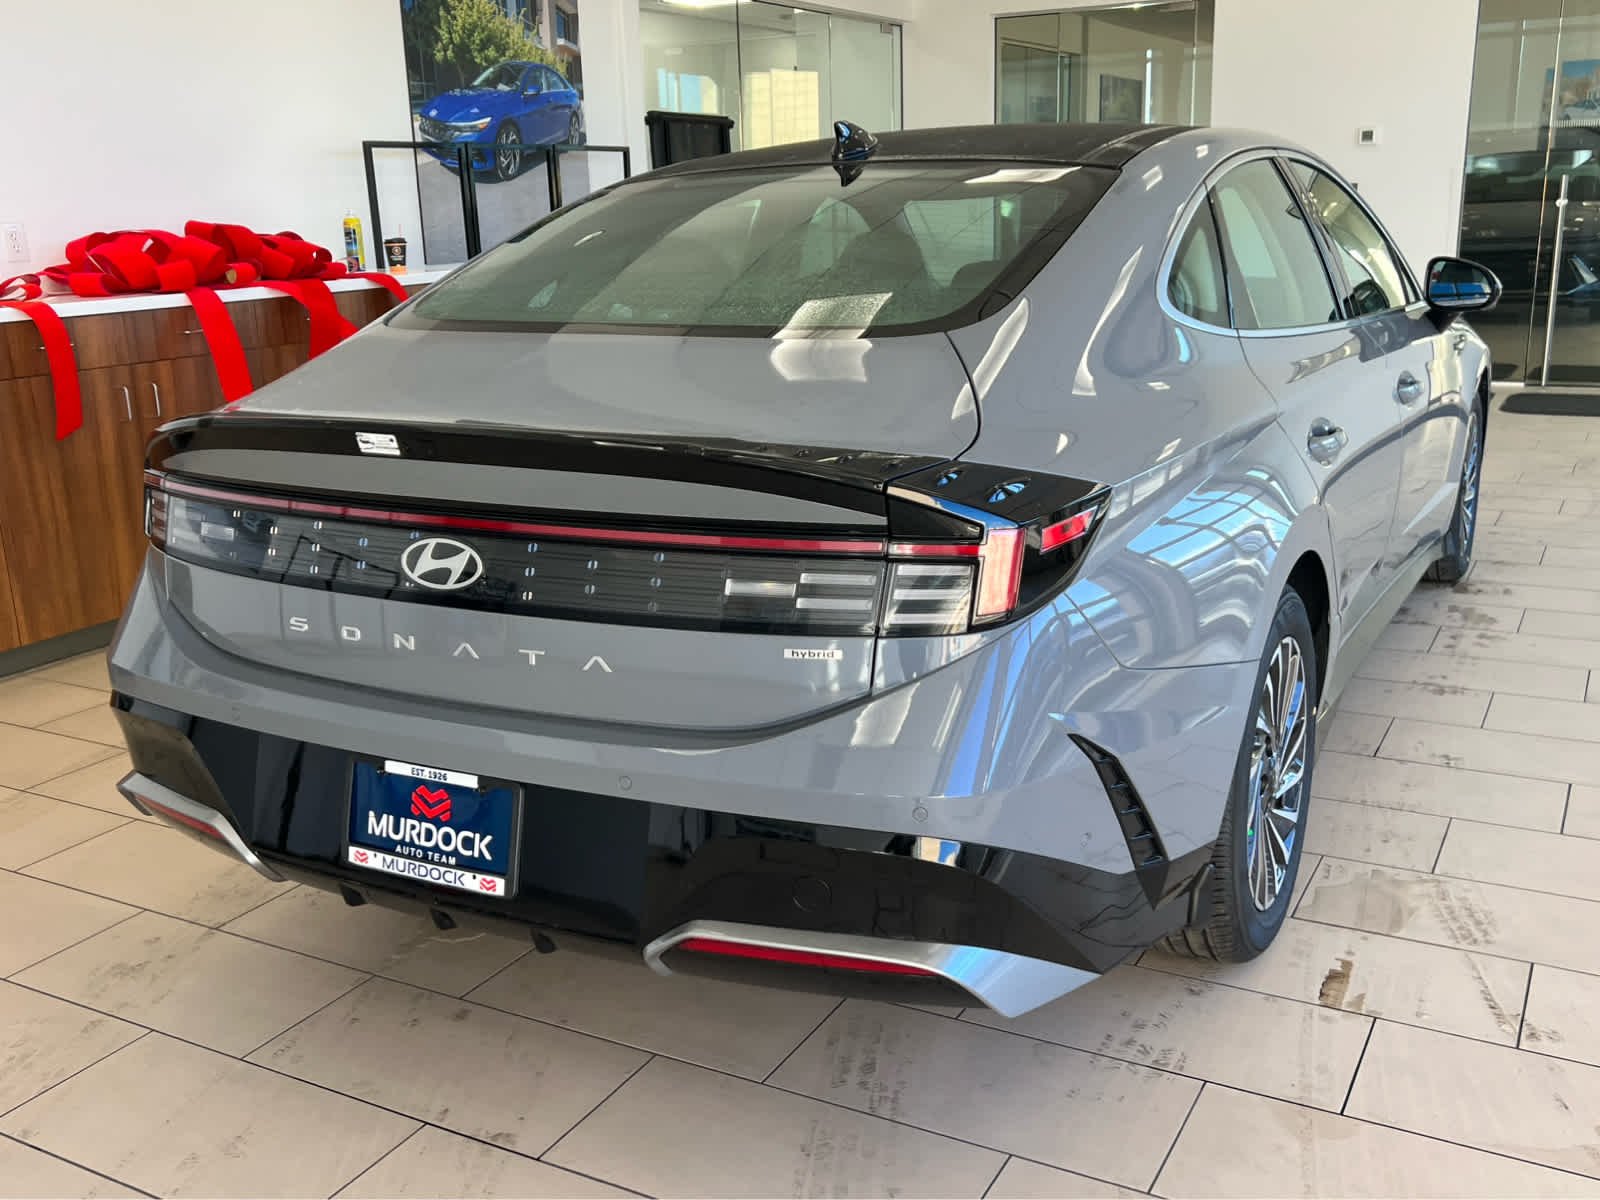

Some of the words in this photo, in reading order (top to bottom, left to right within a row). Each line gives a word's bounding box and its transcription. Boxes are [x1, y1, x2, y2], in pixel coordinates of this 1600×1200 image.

[289, 616, 613, 673] SONATA
[791, 649, 835, 659] hybrid
[411, 767, 426, 778] EST.
[428, 770, 448, 782] 1926
[367, 810, 493, 861] MURDOCK
[395, 845, 424, 859] AUTO
[427, 851, 456, 865] TEAM
[382, 855, 465, 886] MURDOCK
